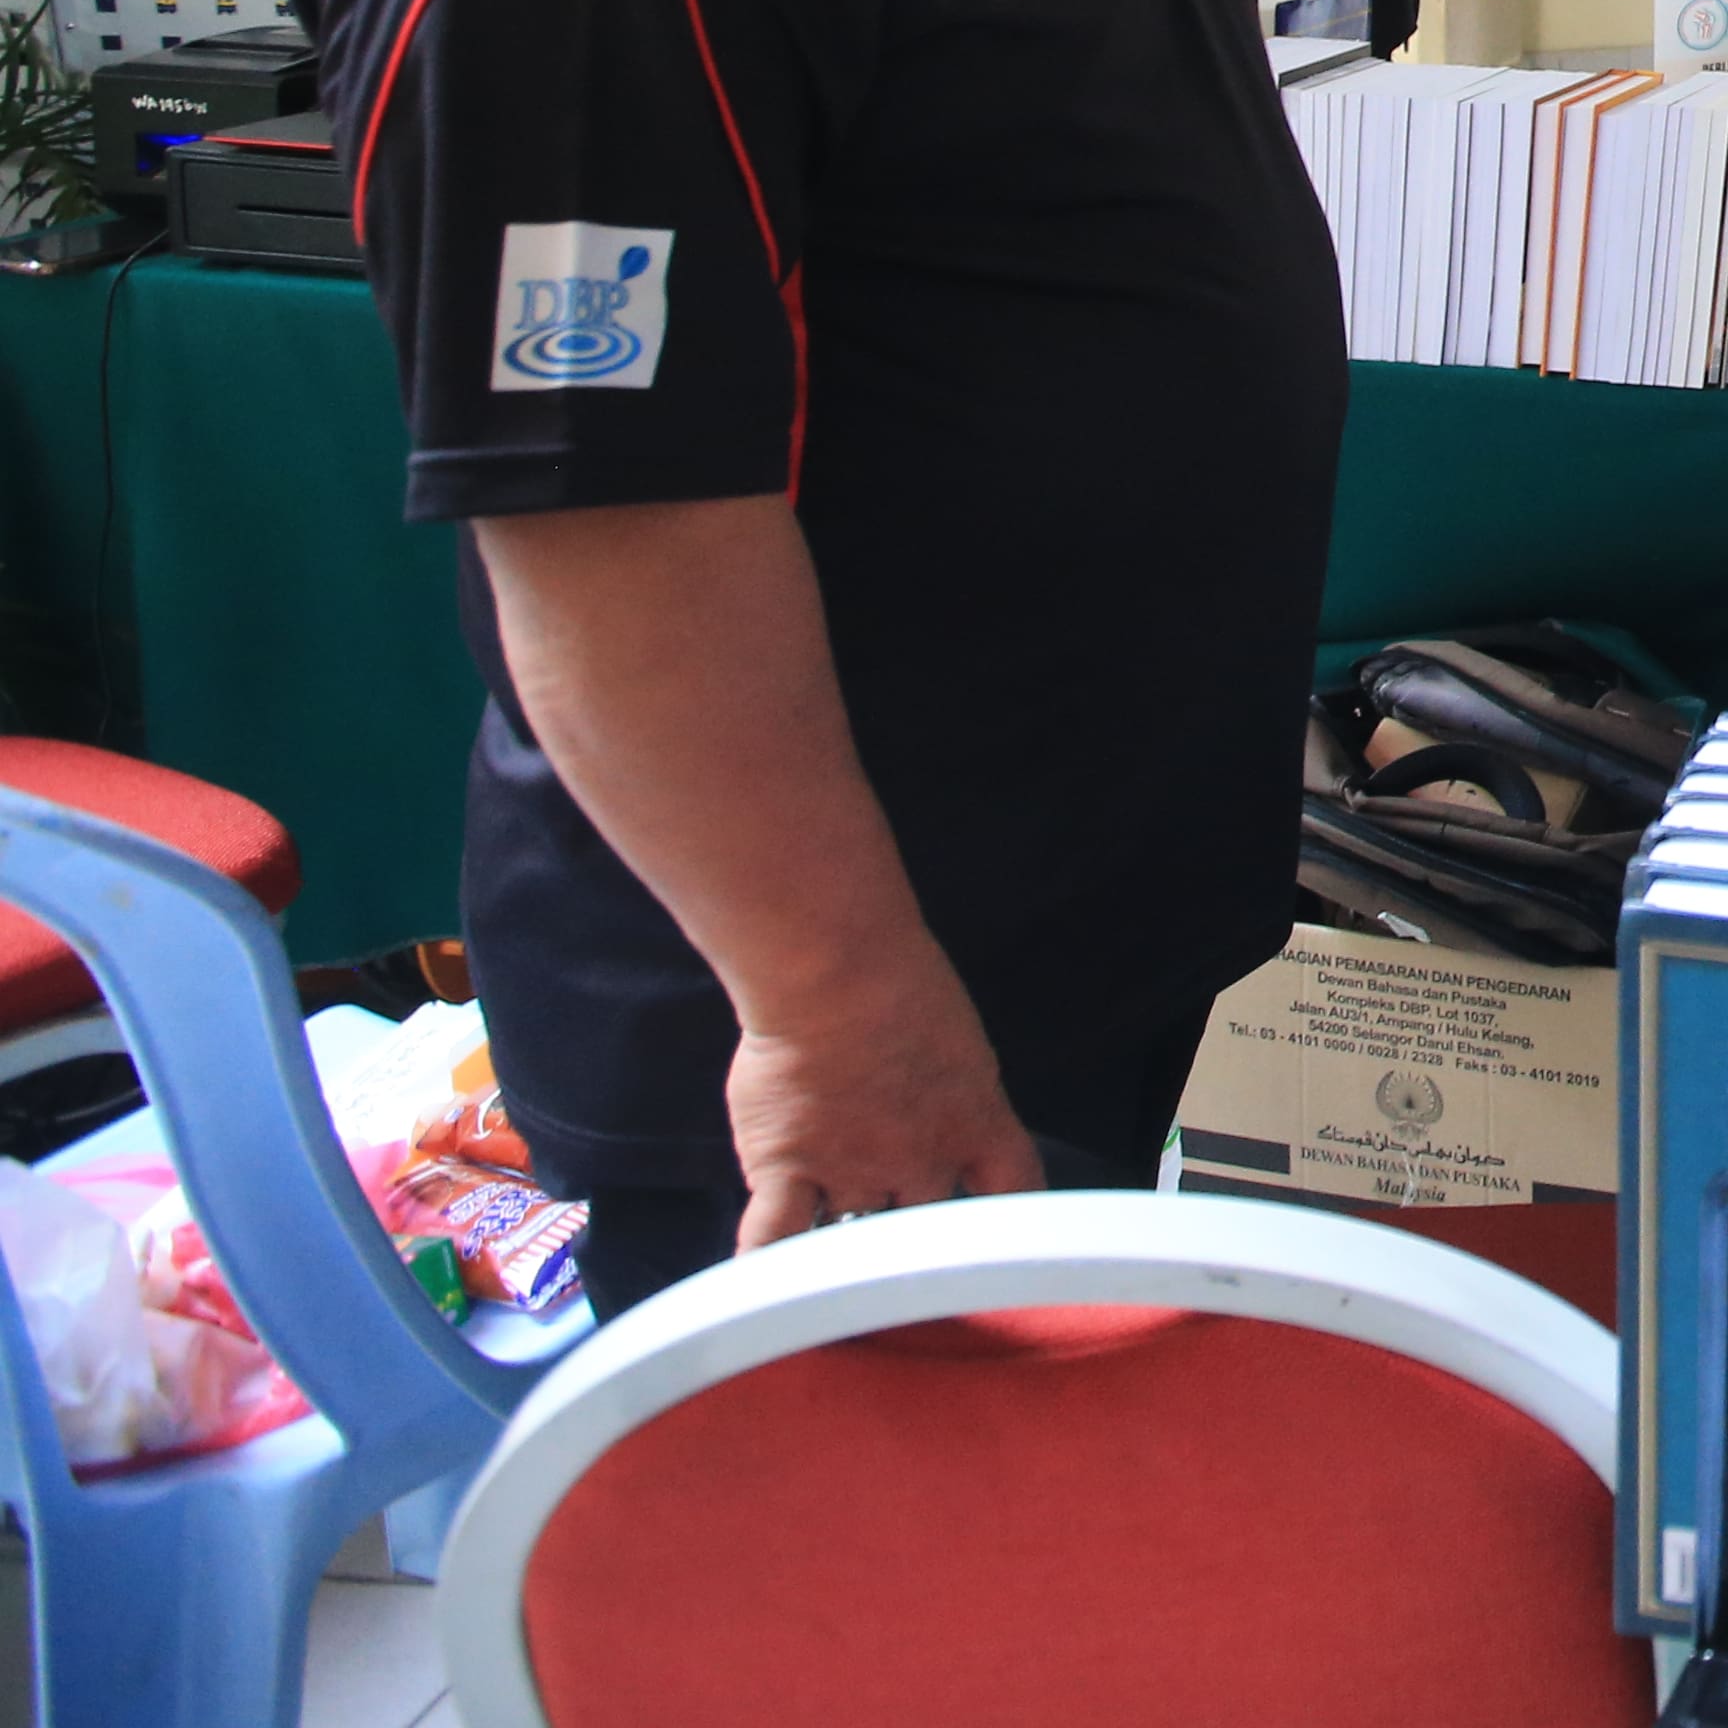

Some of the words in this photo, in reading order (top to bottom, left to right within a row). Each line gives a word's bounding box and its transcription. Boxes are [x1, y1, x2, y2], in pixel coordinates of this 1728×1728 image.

[514, 277, 629, 331] DBP
[1317, 972, 1363, 989] Dewan
[1368, 979, 1418, 996] Bahasa
[1422, 988, 1448, 1000] dan
[1452, 991, 1507, 1010] Pustaka
[1327, 991, 1395, 1012] Kompleks
[1437, 1007, 1459, 1020] Lot
[1464, 1011, 1498, 1027] 1037,
[1290, 1001, 1326, 1016] Jalan
[1375, 1013, 1434, 1035] Ampang
[1437, 1024, 1443, 1033] /
[1446, 1025, 1478, 1039] Hulu
[1482, 1029, 1534, 1049] Kelang,
[1309, 1020, 1348, 1037] 54200
[1353, 1026, 1412, 1047] Selangor
[1416, 1035, 1453, 1052] Darul
[1457, 1041, 1504, 1059] Ehsan.
[1260, 1027, 1276, 1040] 03
[1288, 1033, 1319, 1047] 4101
[1324, 1038, 1355, 1053] 0000
[1367, 1044, 1399, 1059] 0028
[1412, 1052, 1443, 1066] 2328
[1456, 1058, 1489, 1073] Faks
[1500, 1065, 1516, 1077] 03
[1530, 1068, 1562, 1083] 4101
[1567, 1072, 1600, 1088] 2019
[1301, 1147, 1353, 1165] DEWAN
[1420, 1164, 1449, 1181] DAN
[1454, 1170, 1520, 1192] PUSTAKA
[1375, 1178, 1447, 1202] Malysia
